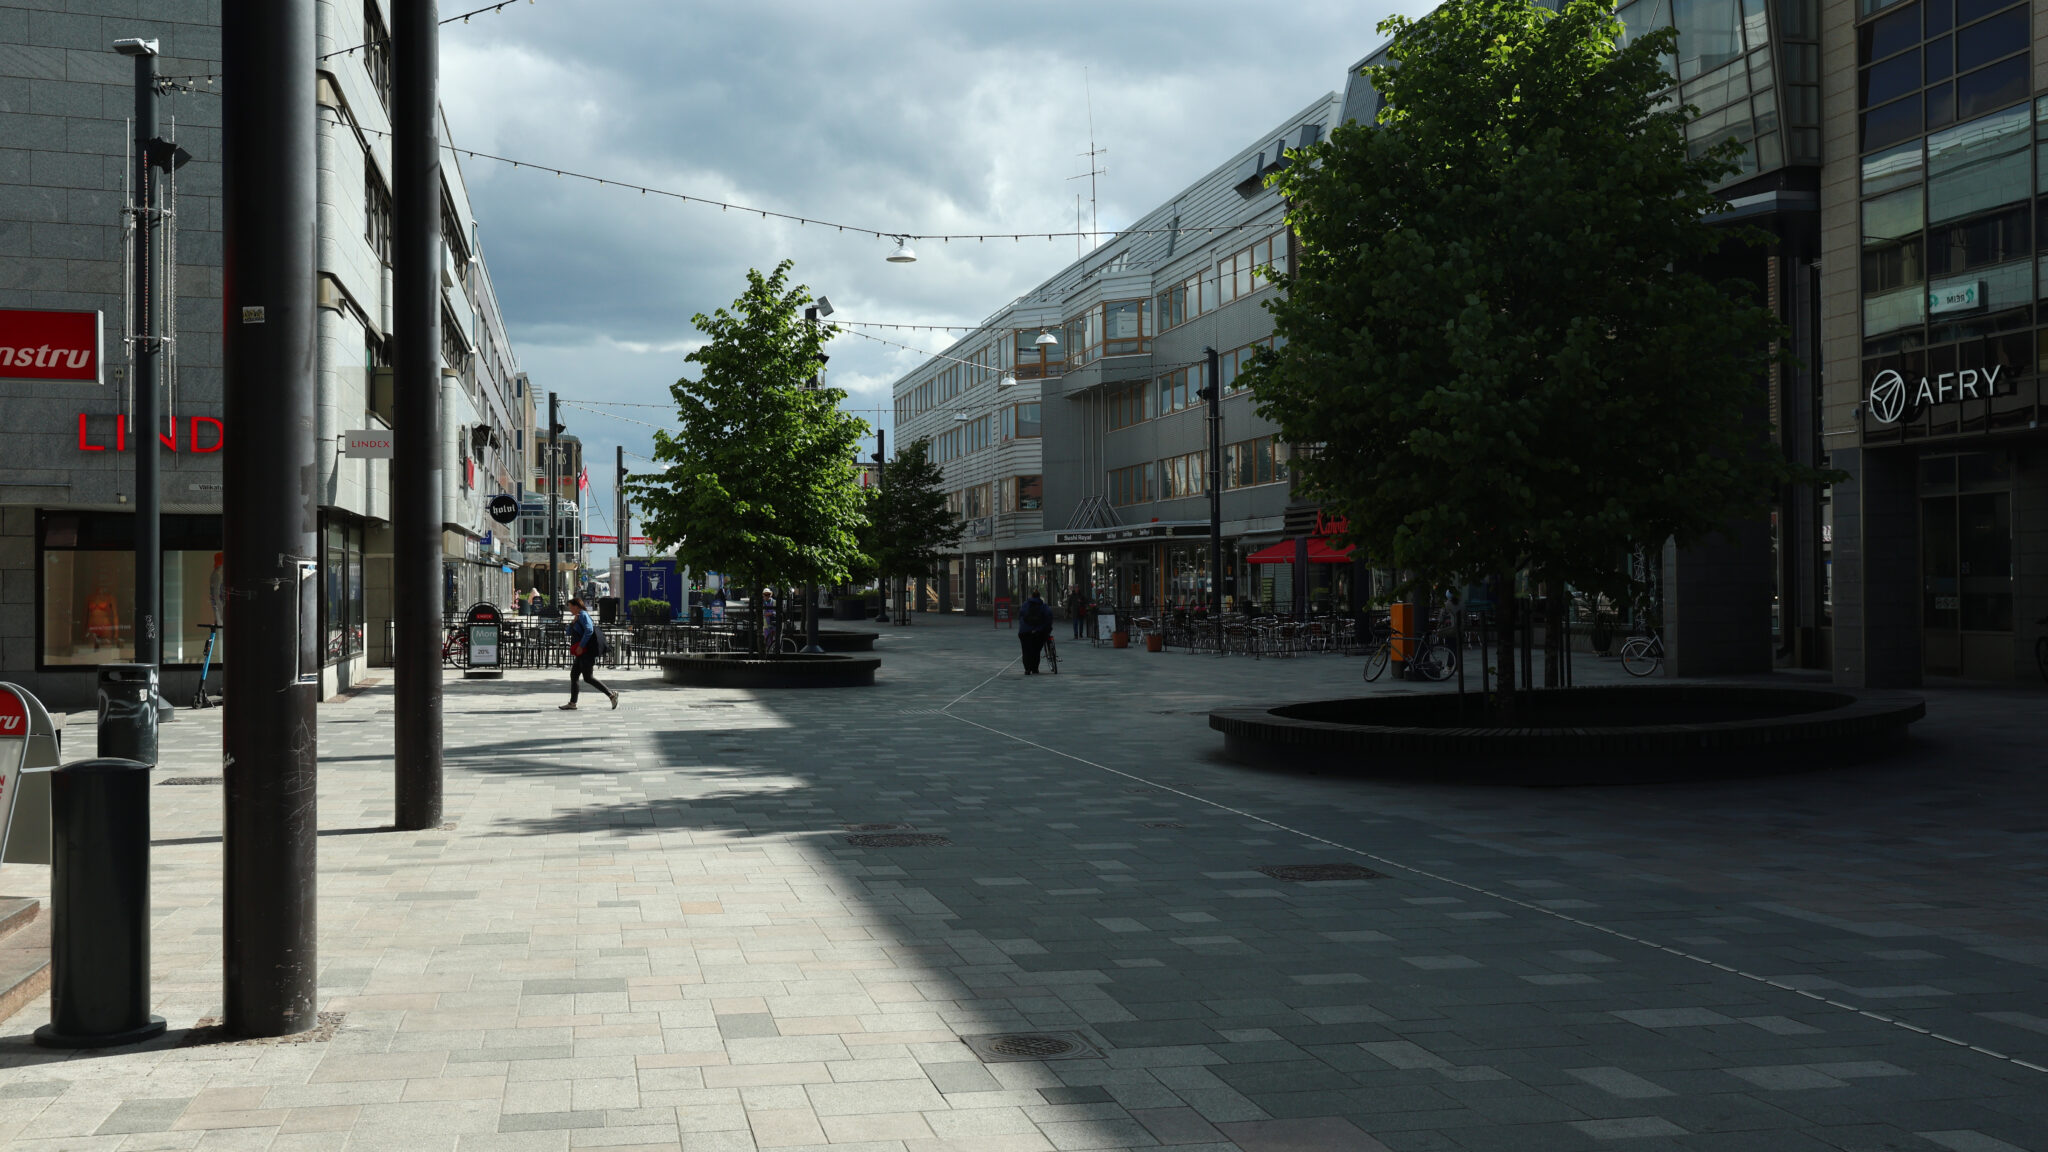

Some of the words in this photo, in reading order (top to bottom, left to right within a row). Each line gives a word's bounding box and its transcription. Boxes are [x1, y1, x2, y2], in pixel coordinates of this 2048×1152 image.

[0, 344, 91, 369] nstru
[1915, 364, 2001, 407] AFRY
[351, 440, 390, 448] LINDEX
